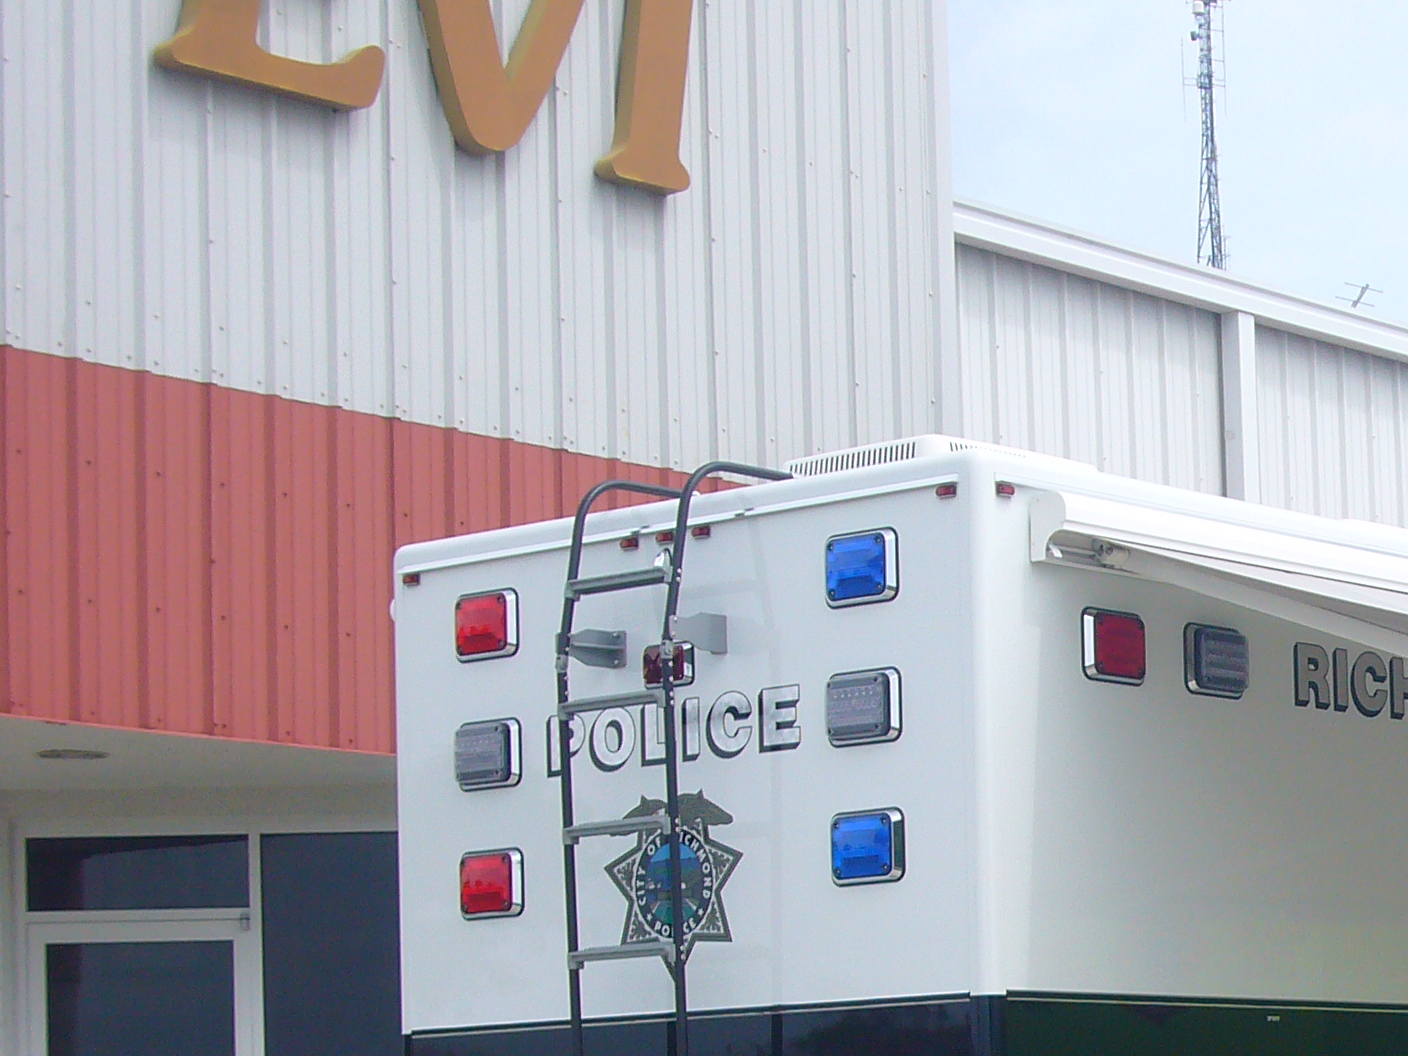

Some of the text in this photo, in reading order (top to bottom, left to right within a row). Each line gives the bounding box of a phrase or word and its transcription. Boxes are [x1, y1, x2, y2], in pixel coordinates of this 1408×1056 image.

[547, 684, 801, 778] POLICE
[636, 831, 714, 906] CITY OF ICHMOND
[653, 916, 697, 938] POCE
